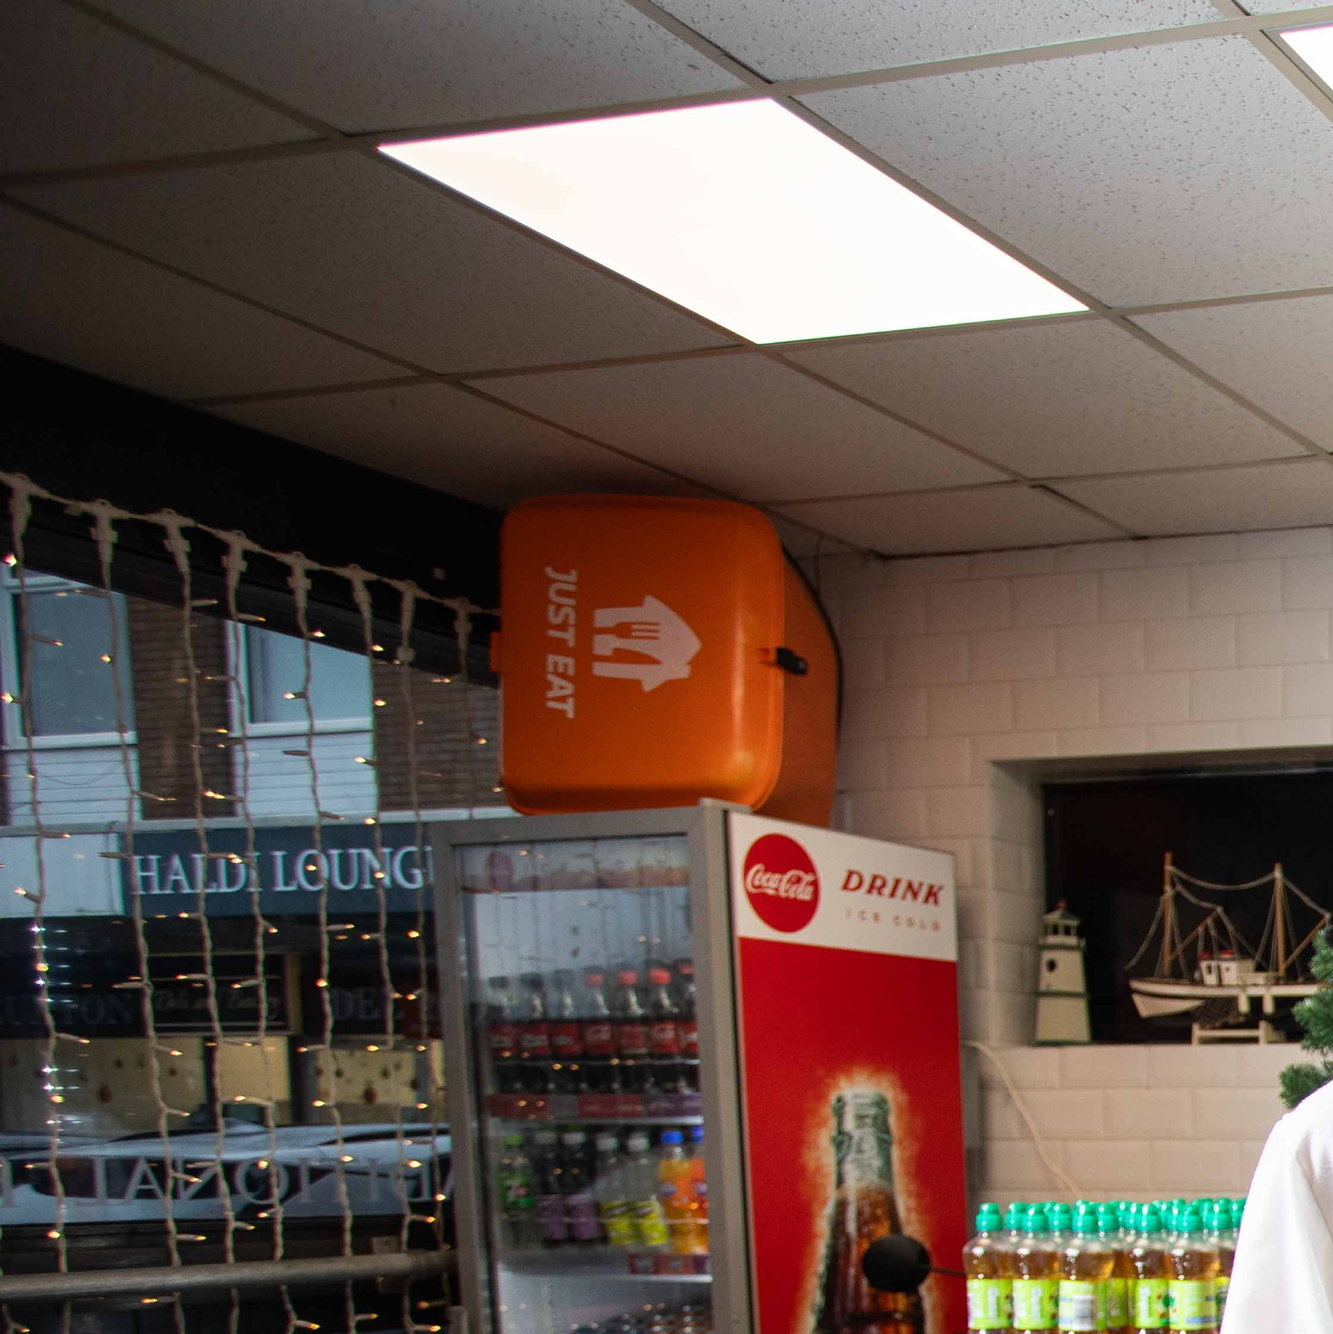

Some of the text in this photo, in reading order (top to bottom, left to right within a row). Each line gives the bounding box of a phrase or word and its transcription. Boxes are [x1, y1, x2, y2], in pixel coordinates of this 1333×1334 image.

[545, 567, 578, 719] JUST EAT
[132, 852, 263, 894] HALDI
[746, 863, 944, 907] Coca-Cola DRINK
